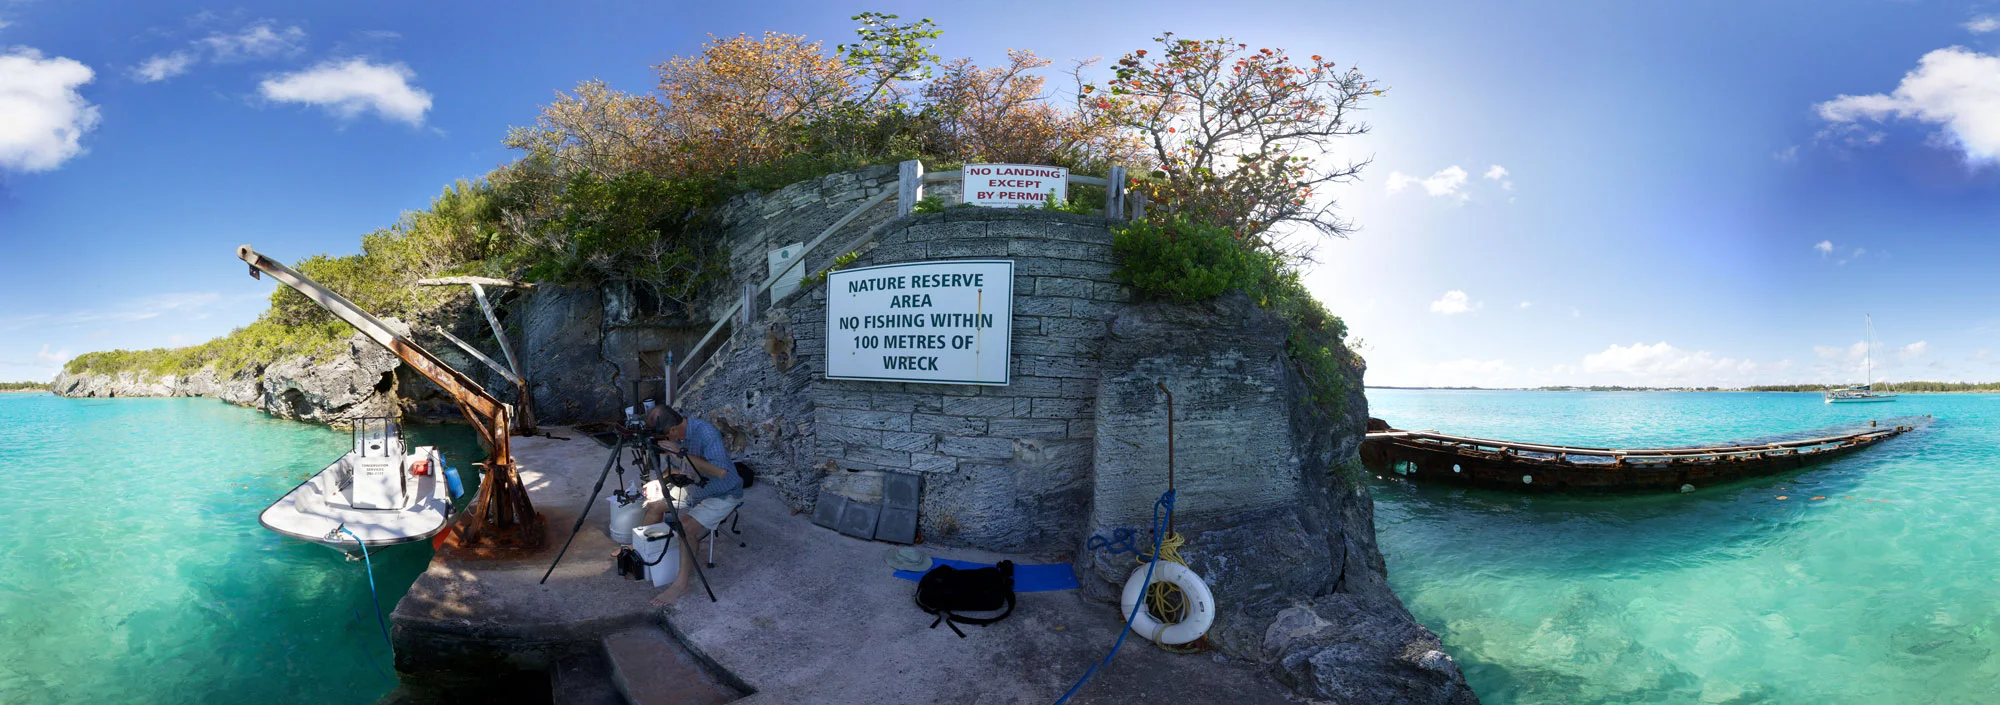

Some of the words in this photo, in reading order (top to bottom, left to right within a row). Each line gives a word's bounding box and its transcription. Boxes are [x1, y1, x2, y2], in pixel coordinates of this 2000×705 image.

[970, 168, 991, 176] NO
[996, 168, 1061, 179] LANDING
[989, 179, 1042, 189] EXCEPT
[977, 191, 995, 200] BY
[848, 276, 906, 293] NATURE
[911, 273, 984, 289] RESERVE
[890, 294, 933, 309] AREA
[839, 316, 860, 330] NO
[864, 313, 925, 329] FISHING
[931, 313, 993, 328] WITHIN
[854, 335, 879, 349] 100
[884, 335, 946, 349] METRES
[951, 335, 974, 350] OF
[883, 356, 938, 371] WRECK
